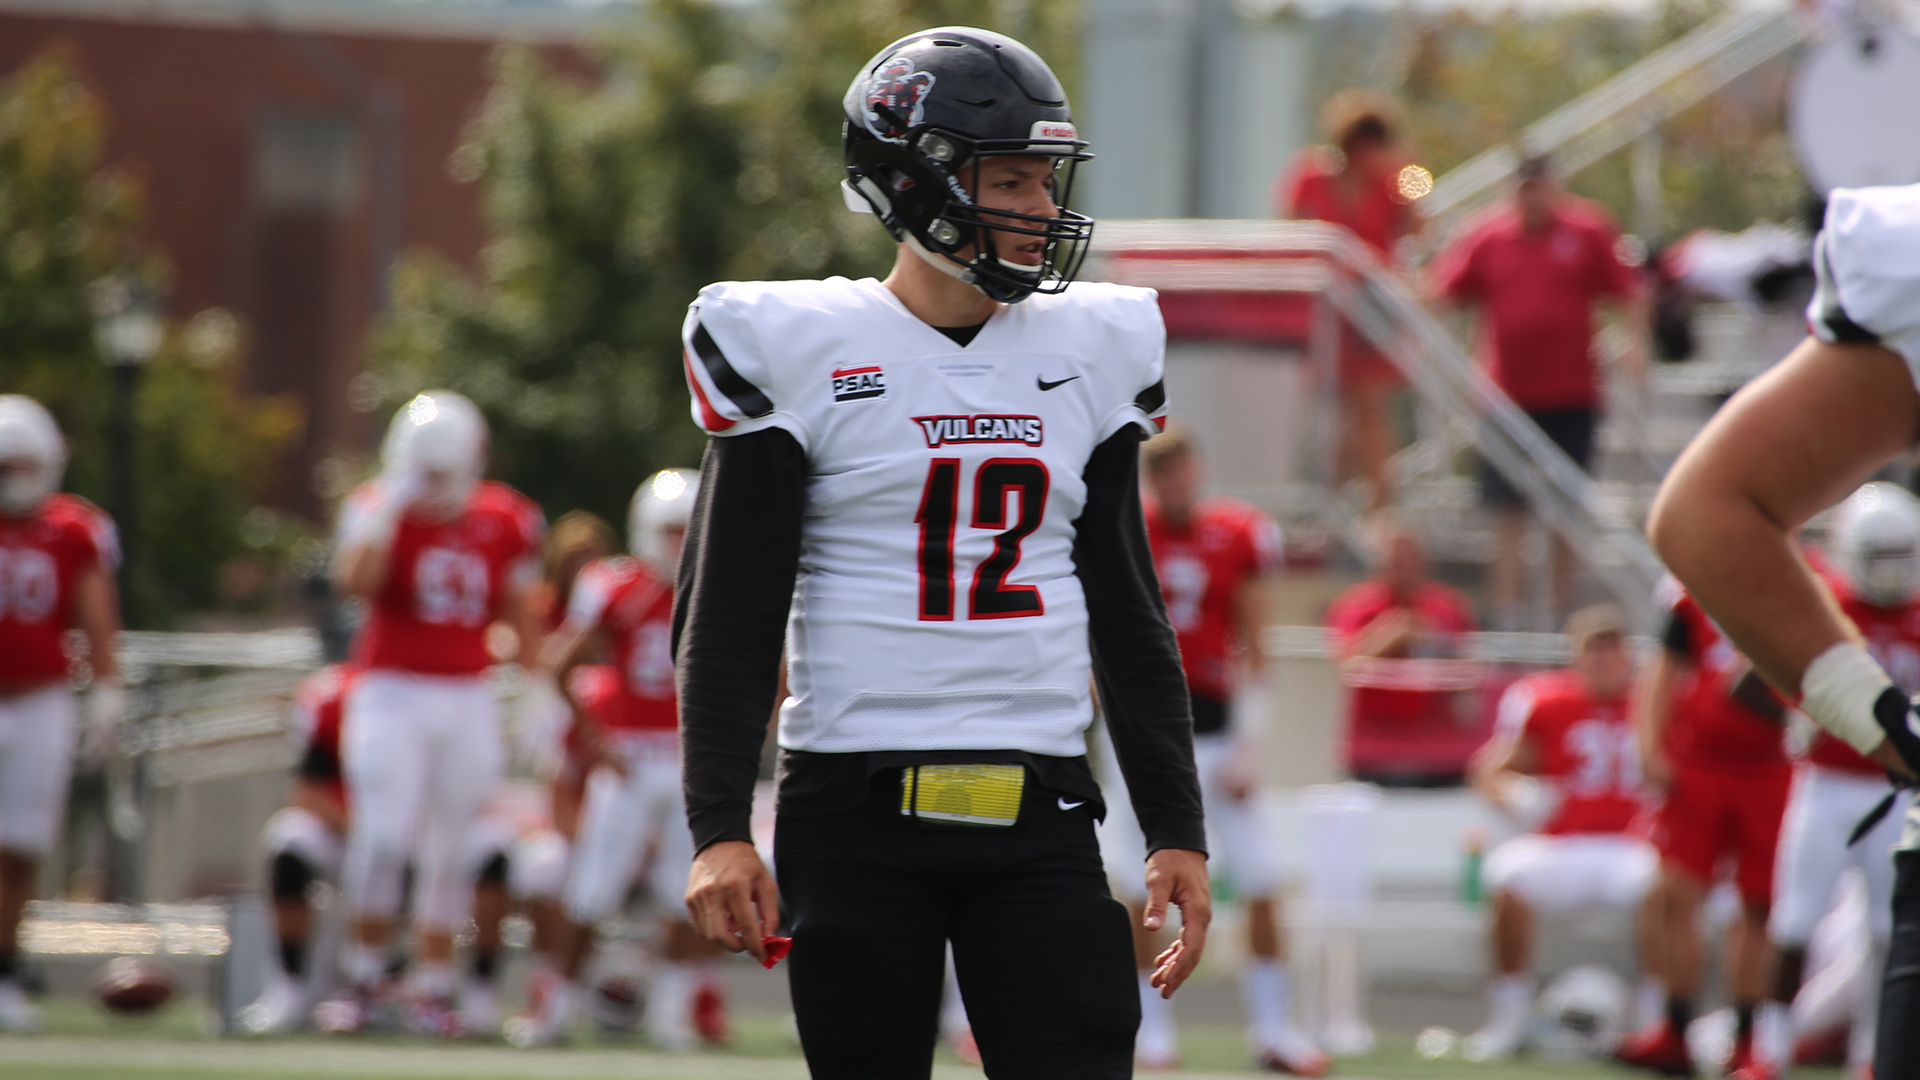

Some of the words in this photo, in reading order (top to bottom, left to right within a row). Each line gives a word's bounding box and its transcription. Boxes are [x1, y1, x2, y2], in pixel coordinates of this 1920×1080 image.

[833, 373, 885, 393] PSAC
[914, 415, 1042, 447] VULCANS
[914, 457, 1050, 621] 12
